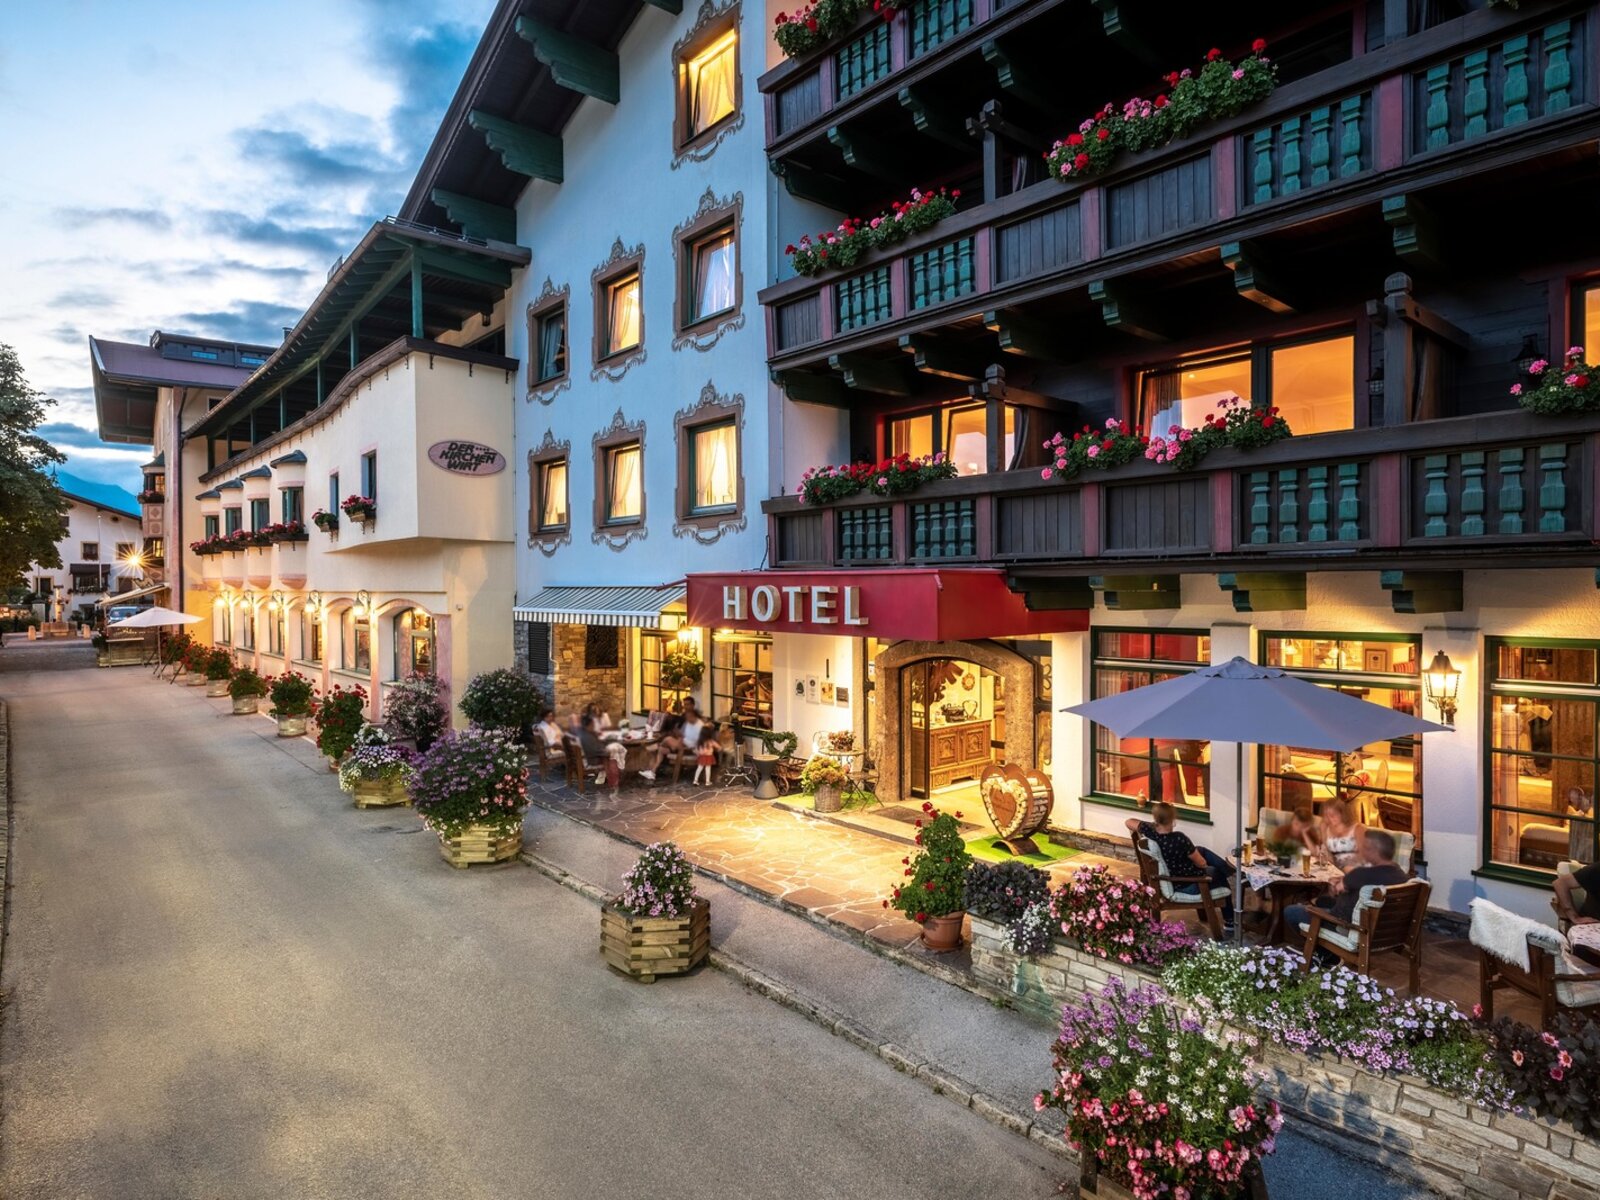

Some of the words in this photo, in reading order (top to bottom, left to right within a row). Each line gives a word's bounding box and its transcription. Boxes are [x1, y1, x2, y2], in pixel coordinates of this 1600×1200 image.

[448, 442, 475, 453] DER
[440, 450, 496, 464] KIRCHEN
[447, 460, 481, 472] WIRT
[723, 584, 869, 625] HOTEL
